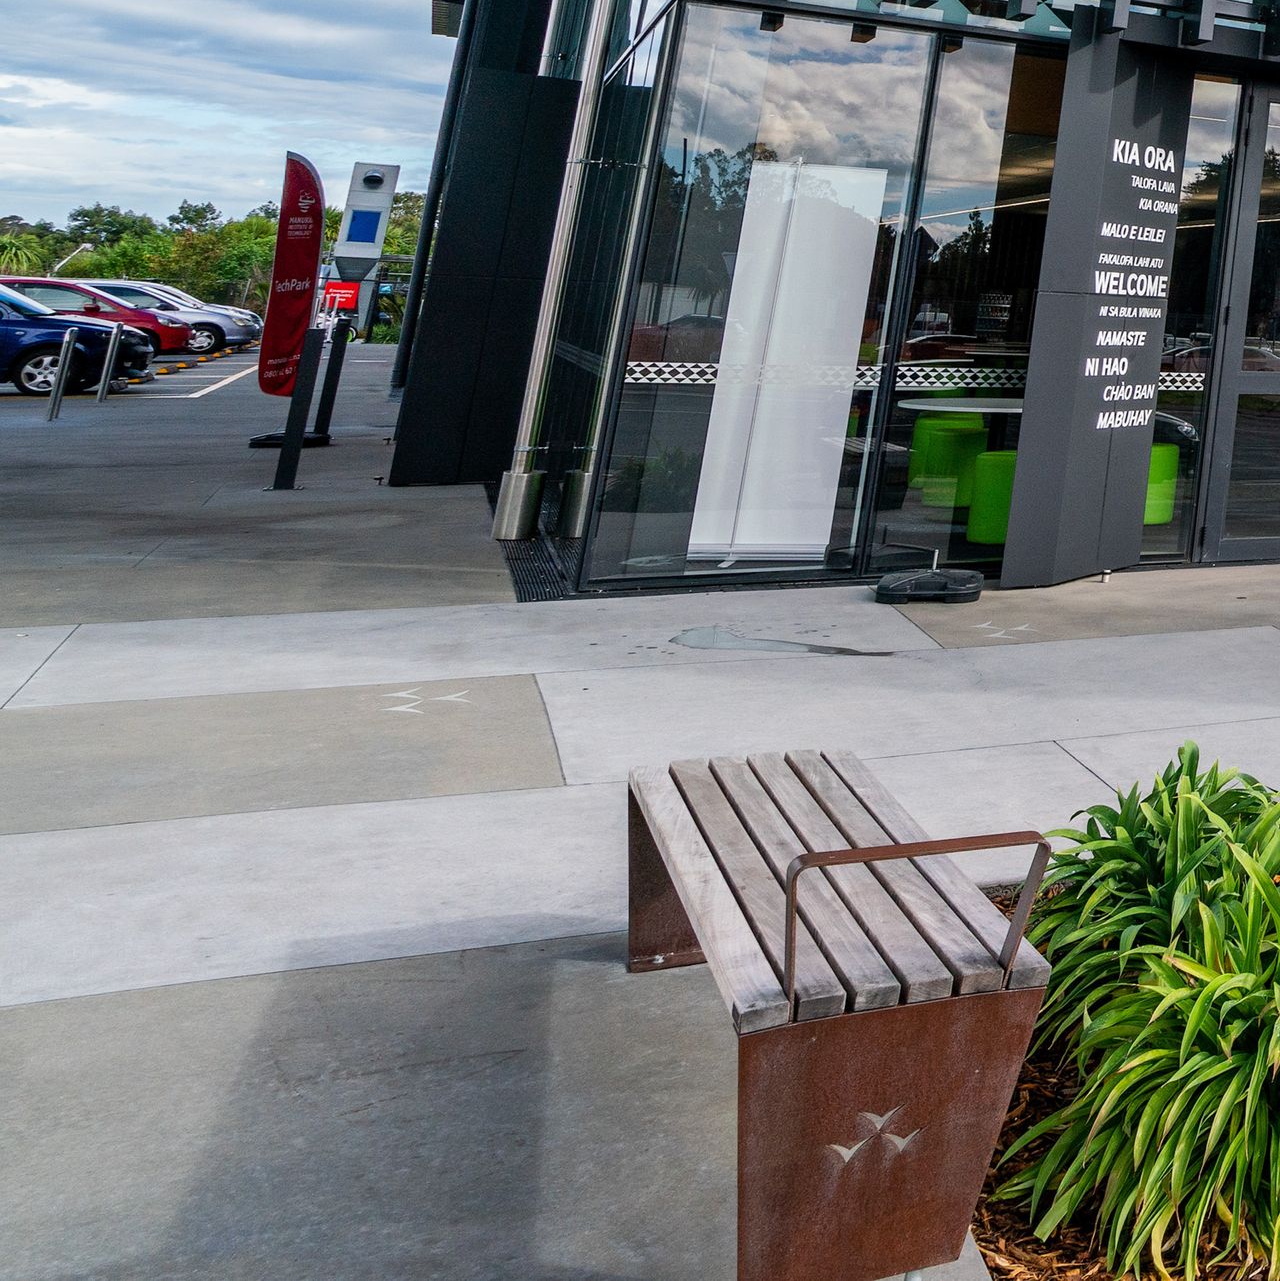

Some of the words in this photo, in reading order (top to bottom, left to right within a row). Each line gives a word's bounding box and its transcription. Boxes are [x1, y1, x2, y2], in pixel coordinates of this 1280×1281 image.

[1112, 139, 1140, 166] KIA
[1144, 146, 1175, 173] ORA
[1131, 175, 1157, 191] TALOFA
[1158, 180, 1175, 194] LAVA
[1138, 198, 1152, 211] KIA
[1153, 200, 1178, 214] ORANA
[288, 216, 314, 224] MANUKA
[1101, 222, 1129, 239] MALO
[1129, 225, 1138, 240] E
[1138, 227, 1166, 243] LEILEI
[1098, 253, 1134, 267] FAKALOFA
[1150, 258, 1164, 269] ATU
[1095, 271, 1168, 298] WELCOME
[1100, 306, 1108, 317] NI
[1108, 307, 1119, 317] SA
[1119, 307, 1137, 318] BULA
[1138, 307, 1162, 319] VINAKA
[1096, 331, 1147, 346] NAMASTE
[1085, 358, 1099, 376] NI
[1102, 357, 1129, 376] HAO
[1133, 384, 1155, 399] BAN
[1096, 409, 1152, 429] MABUHAY
